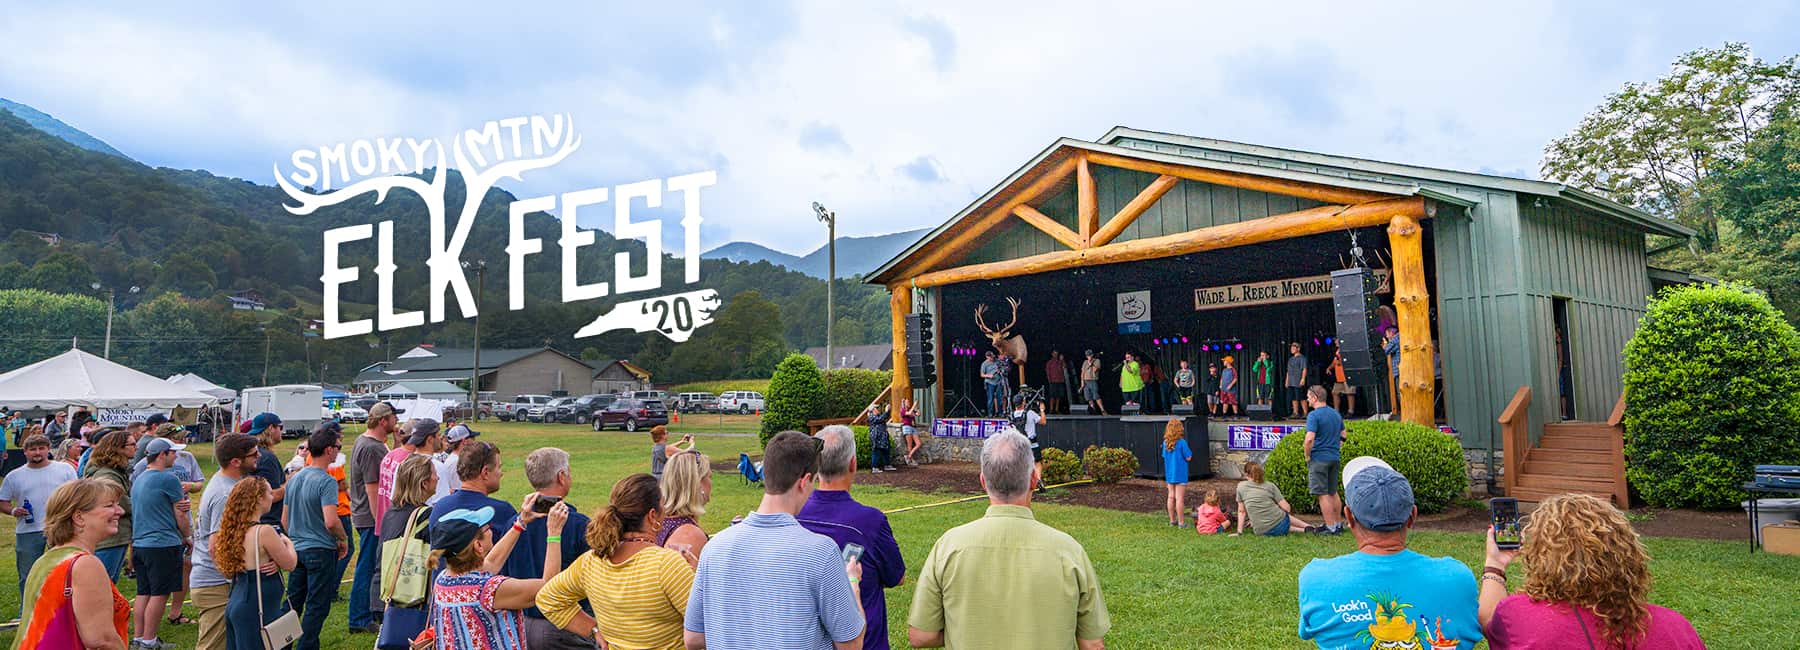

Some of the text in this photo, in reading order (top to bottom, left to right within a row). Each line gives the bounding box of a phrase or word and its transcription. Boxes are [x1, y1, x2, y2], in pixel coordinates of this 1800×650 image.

[1197, 289, 1224, 305] WADE
[1227, 287, 1239, 302] L.
[1242, 285, 1277, 301] REECE
[1332, 600, 1368, 613] Look'n
[1342, 609, 1373, 622] Good
